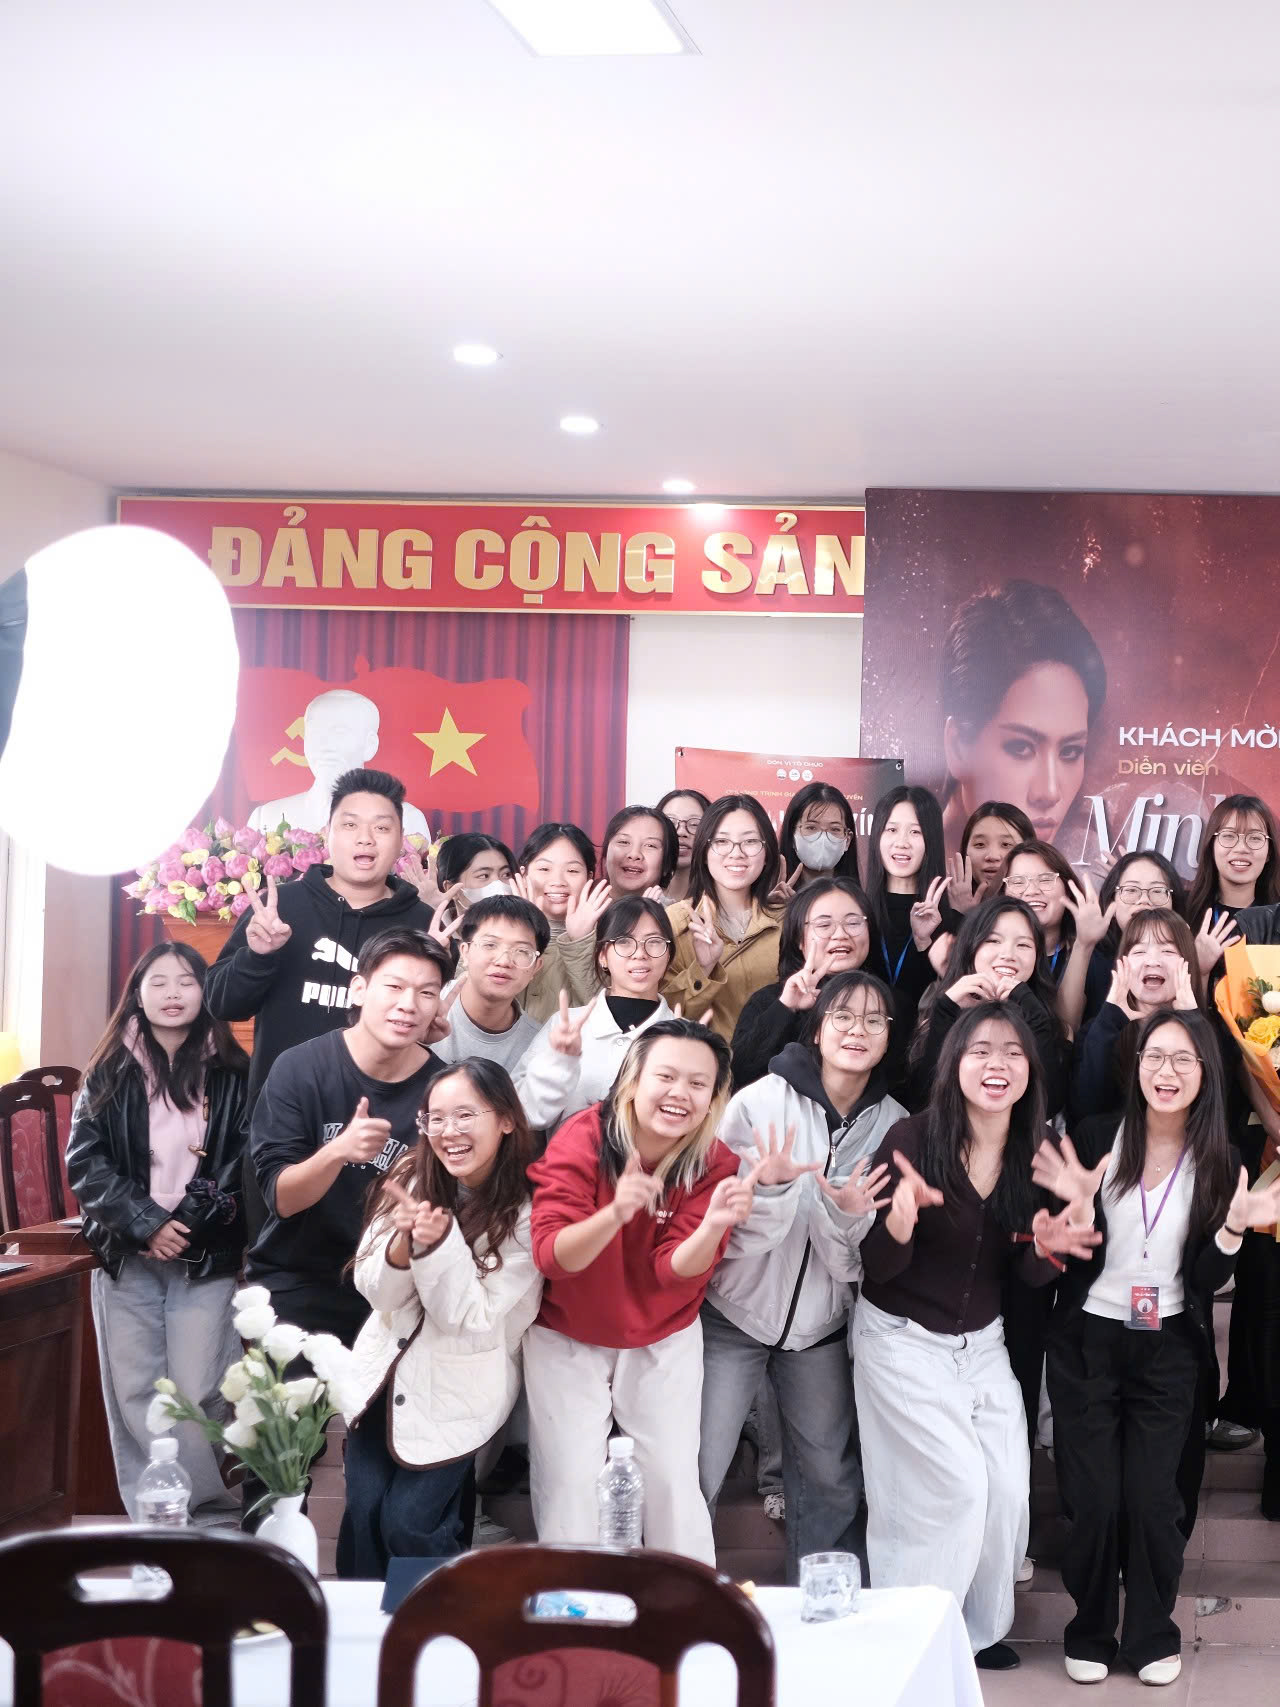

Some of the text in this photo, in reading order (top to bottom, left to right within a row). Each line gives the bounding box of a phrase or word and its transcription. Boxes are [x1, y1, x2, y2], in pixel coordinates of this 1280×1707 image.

[208, 506, 866, 604] ĐẢNG CỘNG SẢN
[1119, 721, 1222, 748] KHÁCH
[1118, 755, 1219, 777] Diễn viên
[1071, 794, 1227, 869] Min
[301, 981, 353, 1010] PUM
